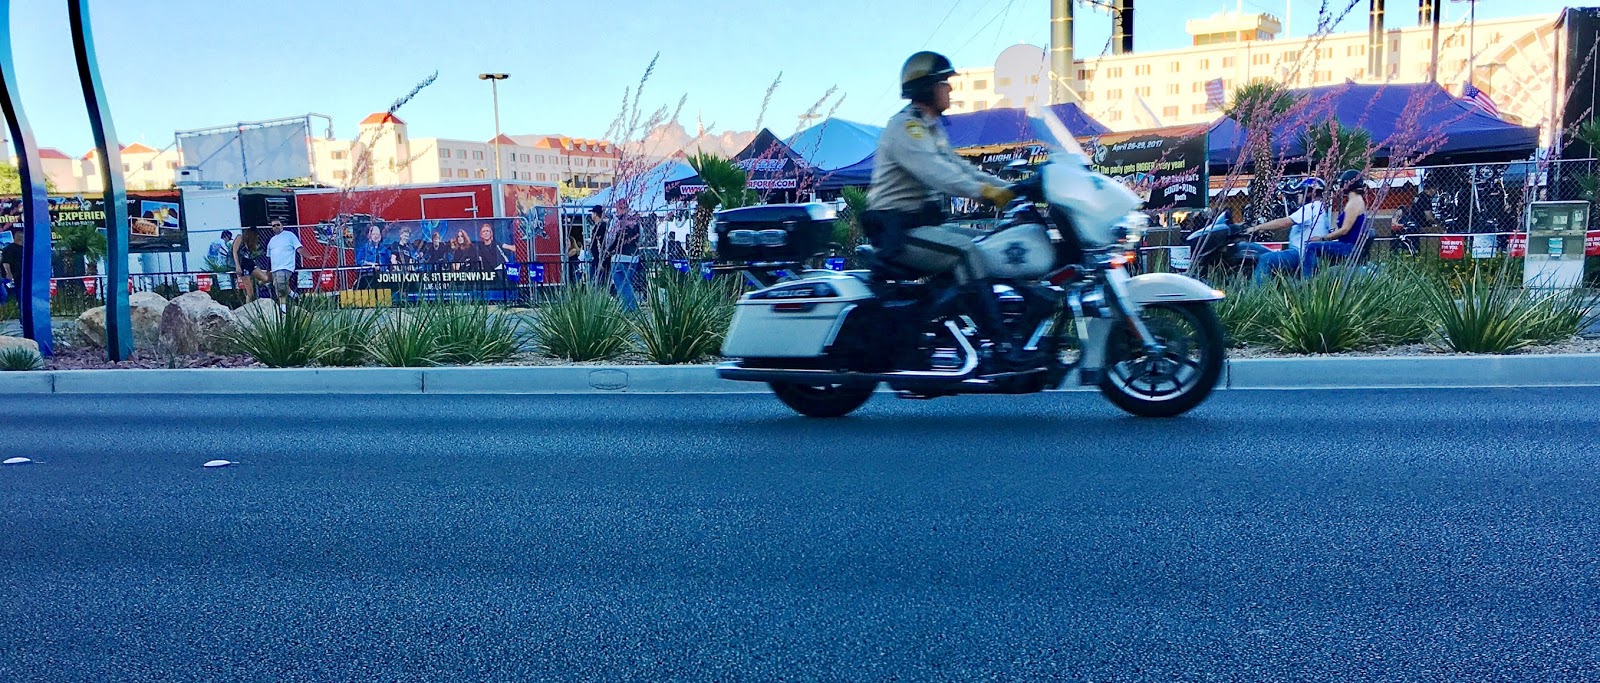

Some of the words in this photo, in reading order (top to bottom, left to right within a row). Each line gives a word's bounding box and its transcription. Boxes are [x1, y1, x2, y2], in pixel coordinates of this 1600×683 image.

[1112, 143, 1127, 152] April
[1147, 139, 1163, 148] 2017
[1100, 165, 1110, 174] The
[1110, 164, 1124, 176] party
[1124, 163, 1136, 174] gets
[1171, 159, 1186, 171] year!
[58, 210, 107, 221] EXPERIEN
[402, 273, 420, 282] KAY
[423, 272, 430, 281] &
